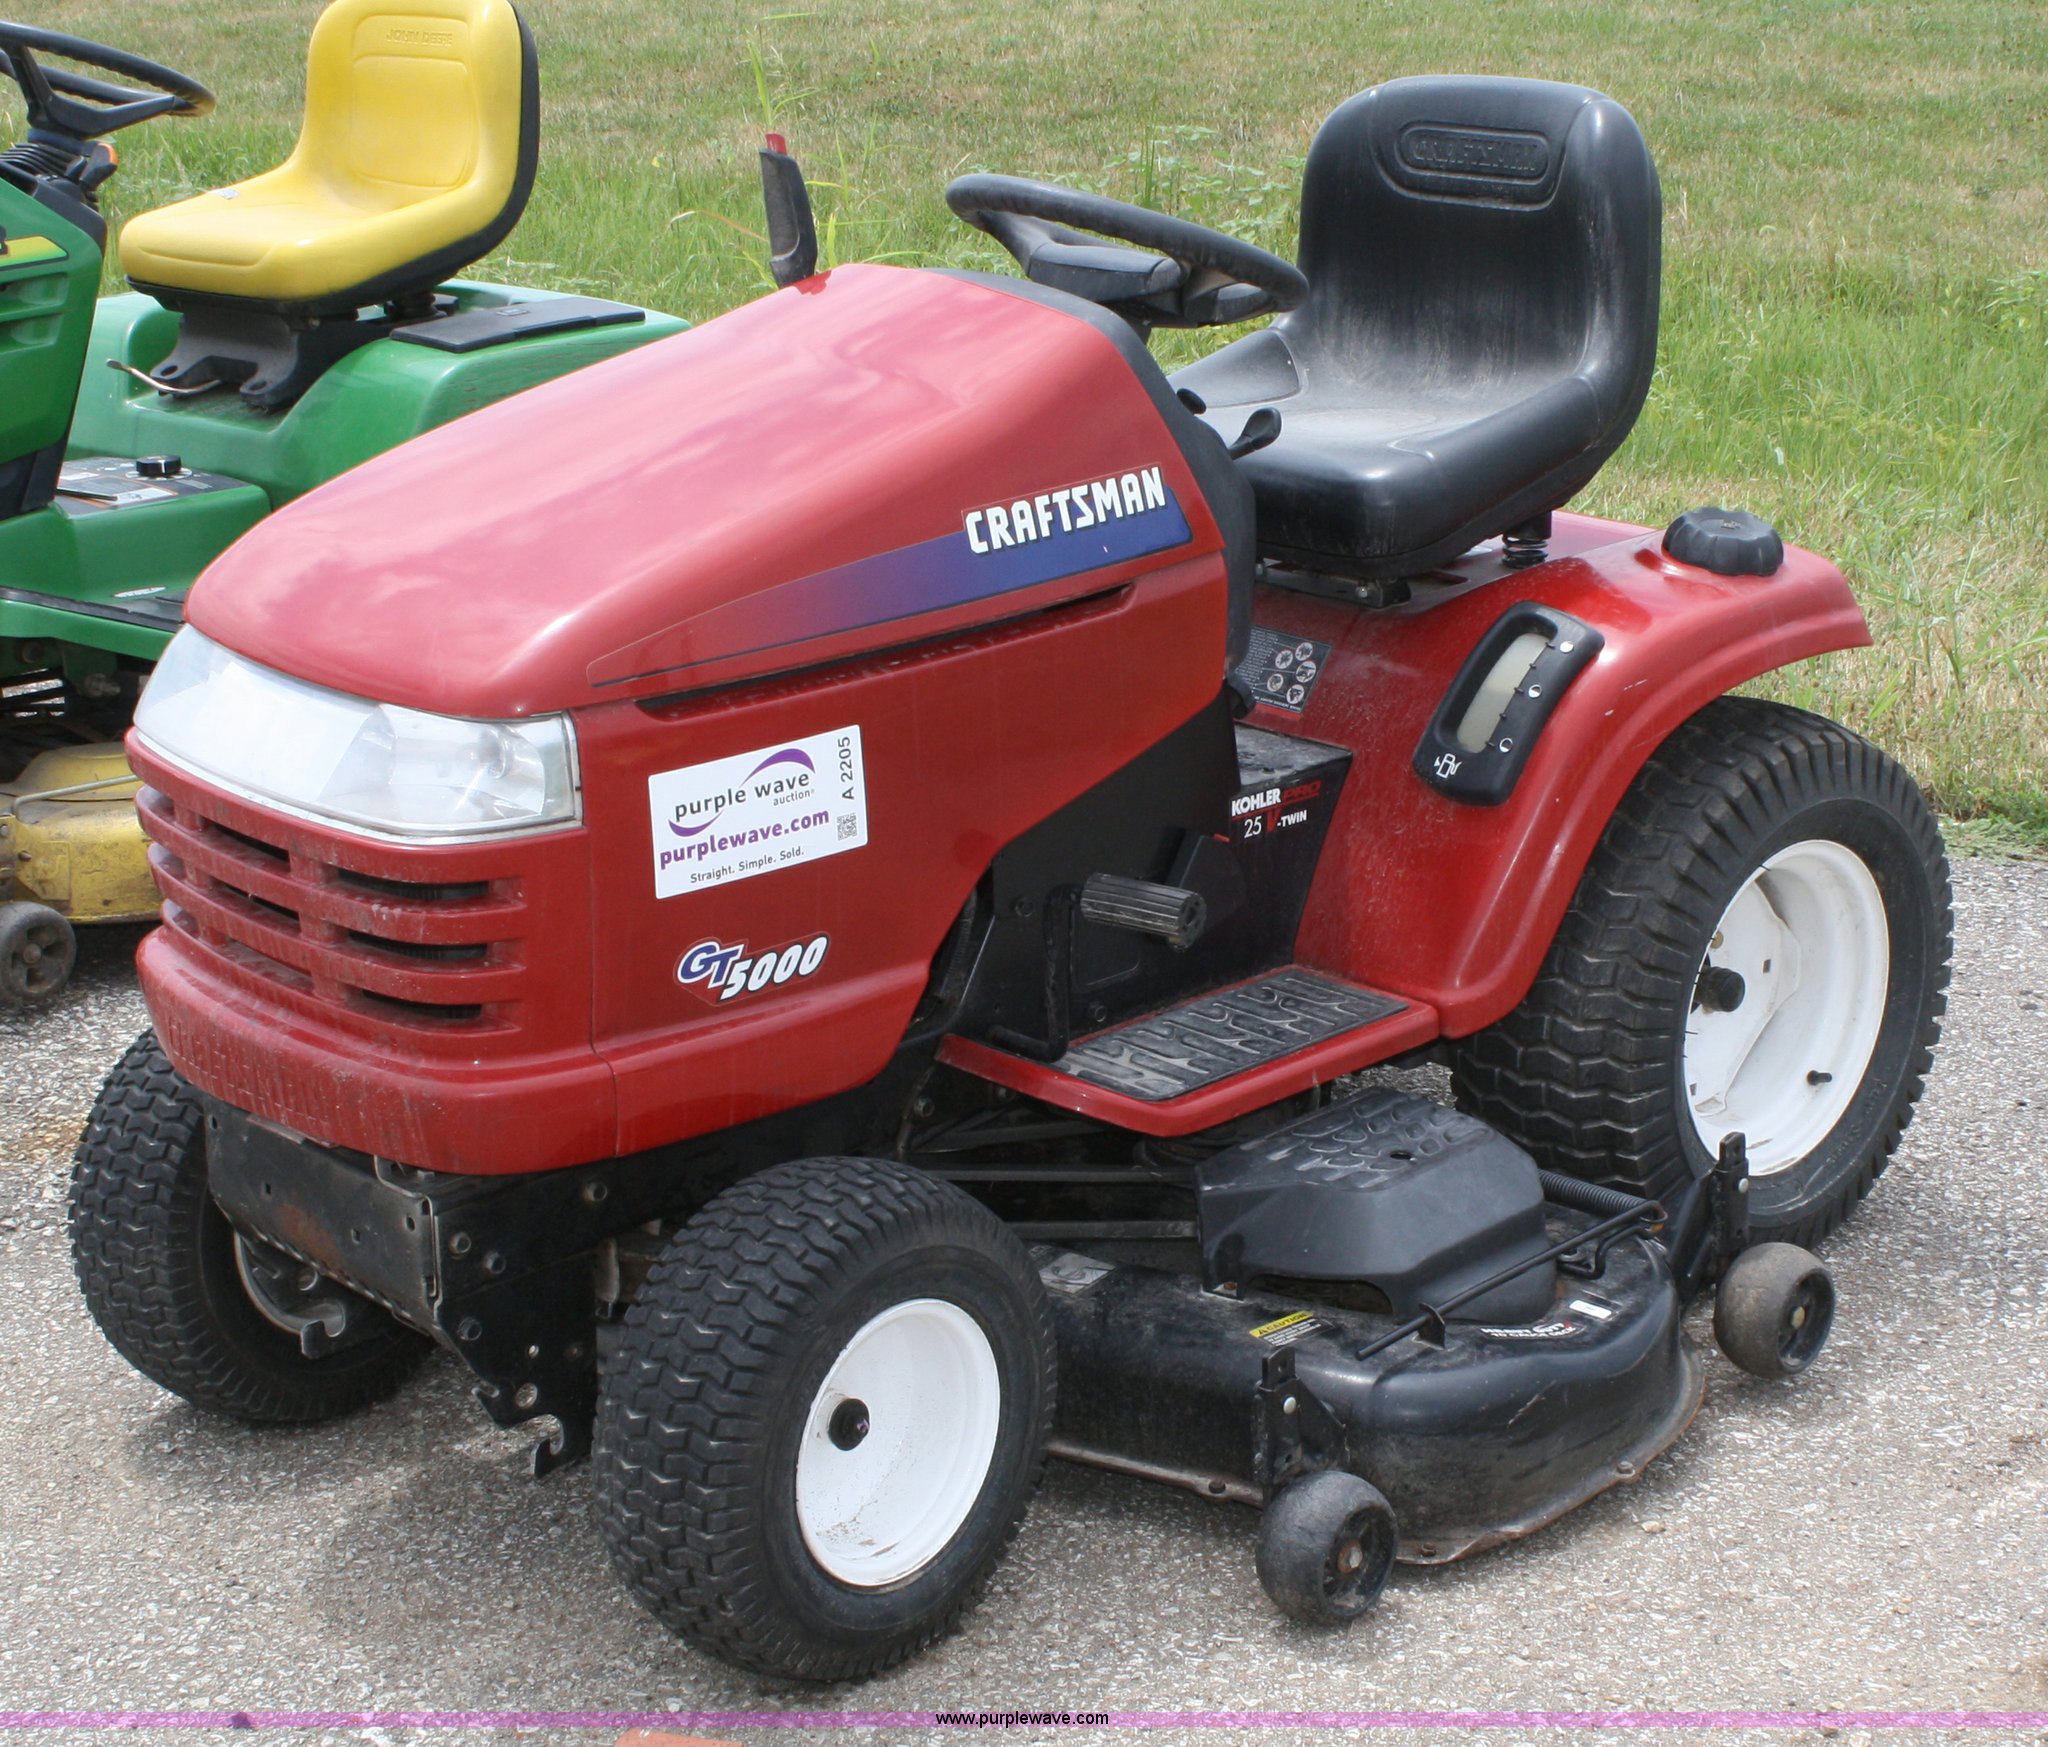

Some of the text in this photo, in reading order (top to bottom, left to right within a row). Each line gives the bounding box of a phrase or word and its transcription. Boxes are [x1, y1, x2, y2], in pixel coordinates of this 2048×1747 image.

[421, 31, 453, 47] DEERE
[965, 466, 1167, 554] CRAFTSMAN
[837, 736, 855, 800] A 2205
[675, 773, 810, 823] purple wave
[1231, 788, 1281, 817] KOHLER
[660, 809, 830, 869] purplewave.com
[1244, 816, 1262, 838] 25
[690, 846, 805, 884] Straight. Simple. Sold.
